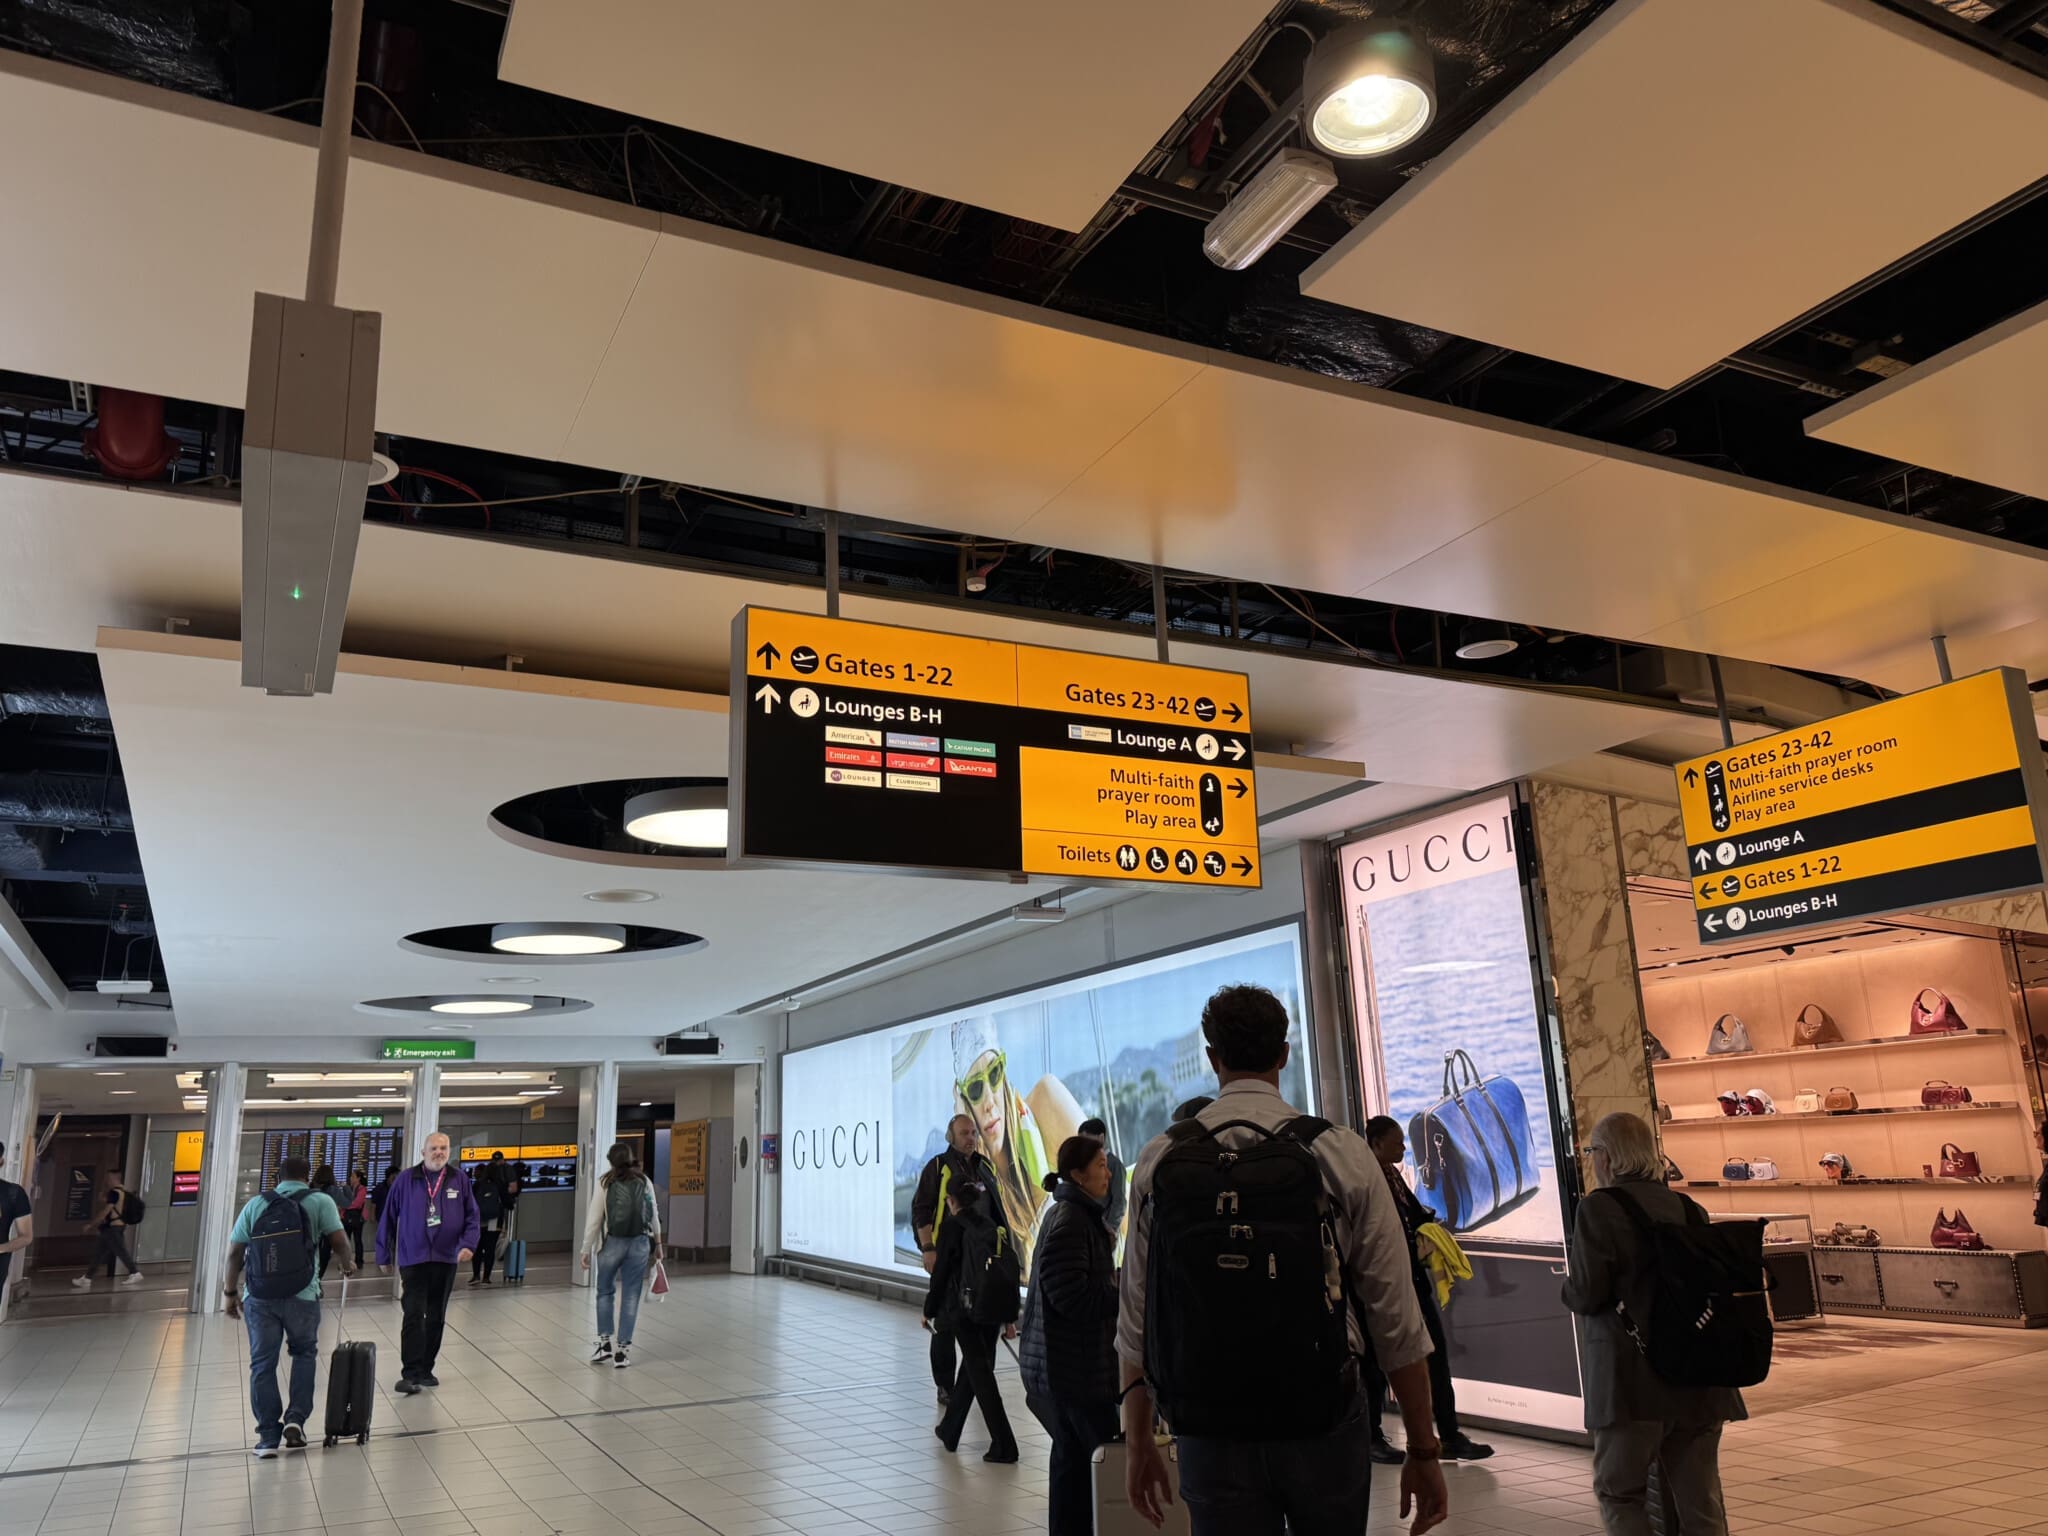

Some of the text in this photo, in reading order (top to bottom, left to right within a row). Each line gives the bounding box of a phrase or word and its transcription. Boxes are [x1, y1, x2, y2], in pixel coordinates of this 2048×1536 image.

[825, 653, 953, 686] Gates 1-22
[825, 696, 942, 725] Lounges B-H
[1066, 683, 1189, 715] Gates 23-42
[831, 731, 865, 741] American
[1117, 730, 1176, 752] Lounge
[1180, 737, 1192, 751] A
[829, 751, 860, 761] Emirates
[1726, 730, 1833, 773] Gates 23-42
[958, 764, 993, 774] QANTAS
[1729, 737, 1897, 791] Multi-faith prayer room
[843, 774, 876, 782] LOUNGES
[1110, 768, 1194, 789] Multi-faith
[1732, 761, 1873, 807] Airline service desks
[1097, 787, 1195, 807] prayer room
[1125, 809, 1196, 829] Play area
[1735, 800, 1796, 823] Play area
[1058, 845, 1111, 863] Toilets
[1352, 815, 1513, 892] GUCCI
[1738, 830, 1805, 856] Lounge A
[1744, 855, 1842, 889] Gates 1-22
[1749, 893, 1838, 922] Lounges B-H
[402, 1048, 456, 1058] Emergency exit
[792, 1120, 880, 1171] GUCCI
